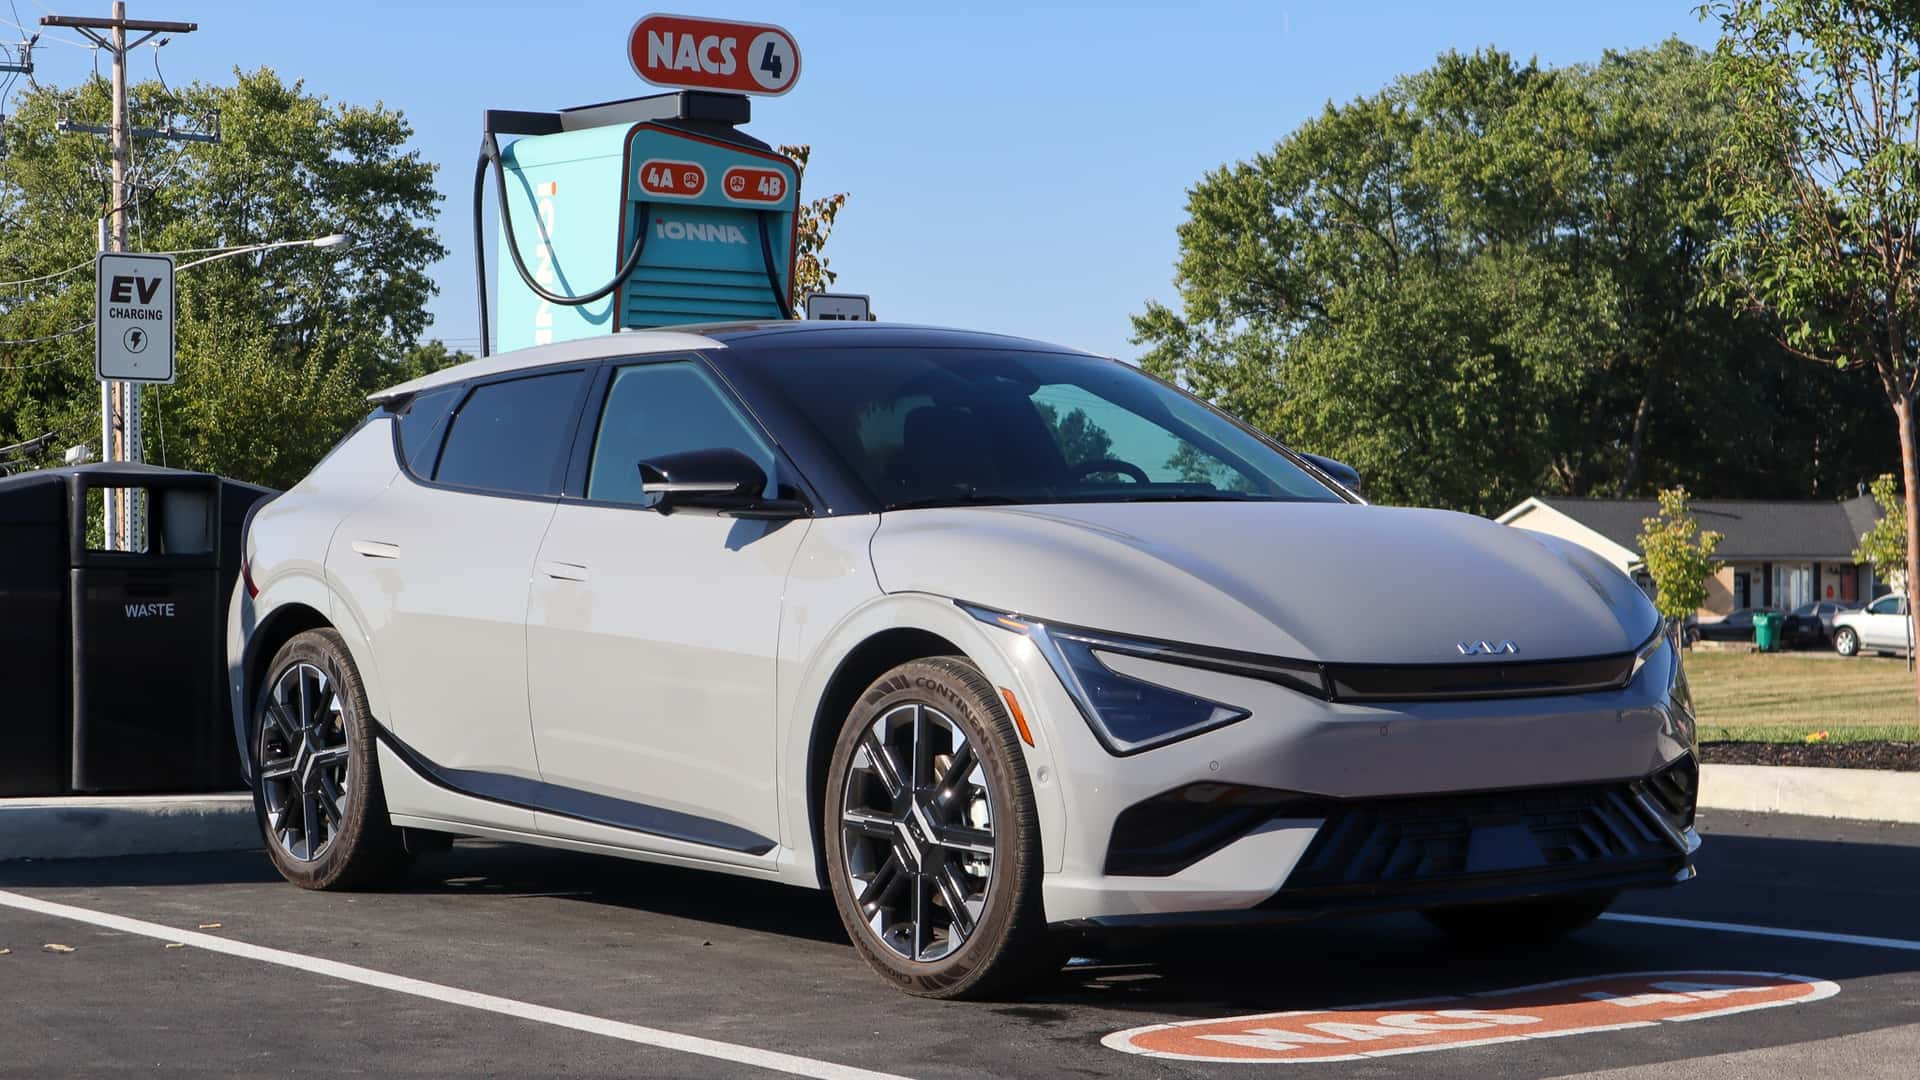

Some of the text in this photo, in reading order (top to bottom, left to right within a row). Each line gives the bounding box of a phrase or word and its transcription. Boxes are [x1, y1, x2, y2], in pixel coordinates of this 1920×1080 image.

[648, 31, 782, 79] NACS 4
[647, 167, 674, 188] 4A
[757, 176, 781, 196] 4B
[110, 275, 162, 304] EV
[109, 307, 163, 320] CHARGING
[125, 603, 175, 618] WASTE
[1194, 1009, 1543, 1050] NACS
